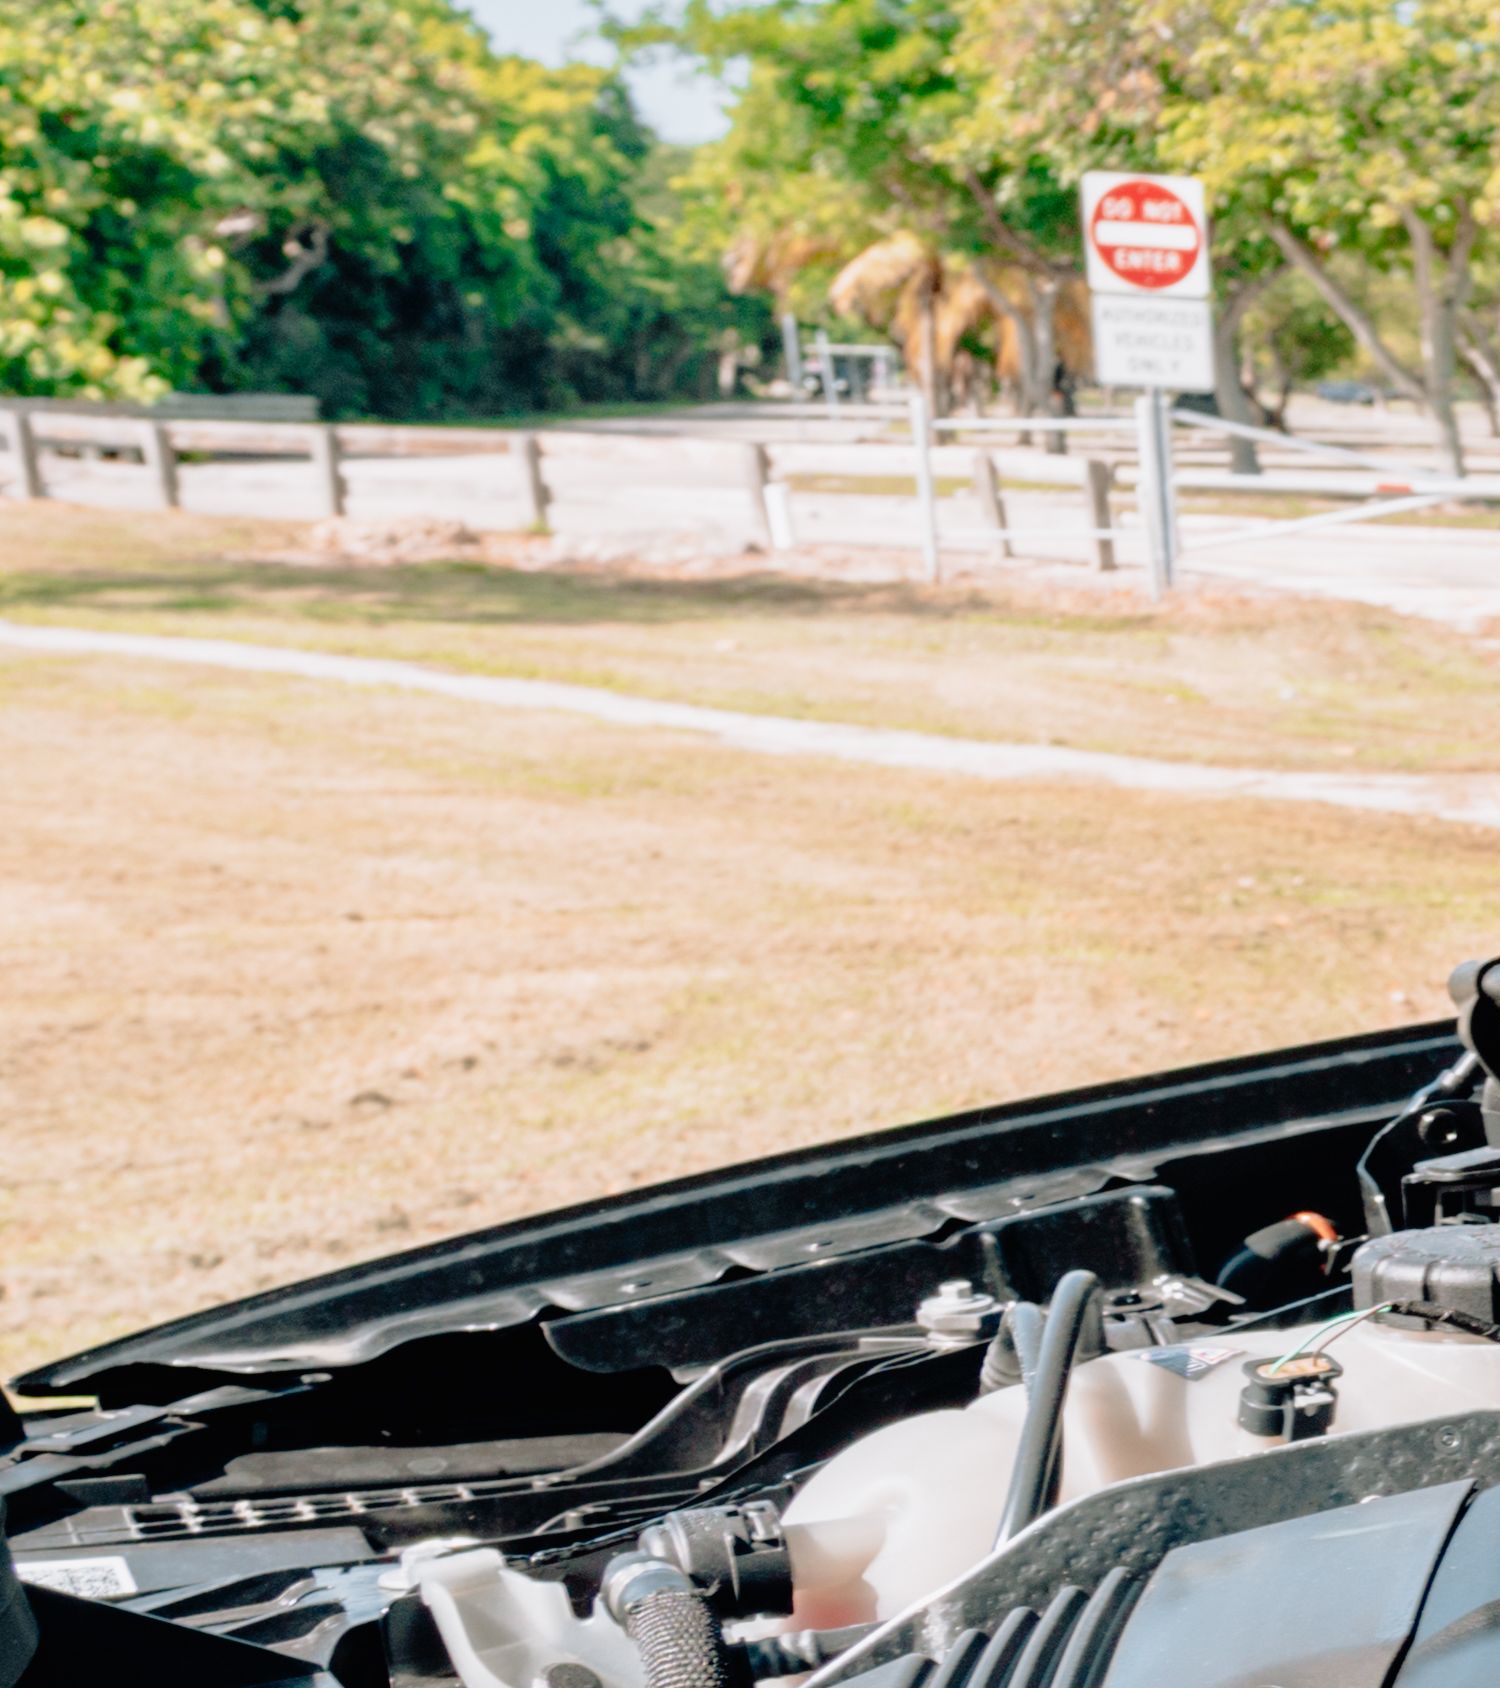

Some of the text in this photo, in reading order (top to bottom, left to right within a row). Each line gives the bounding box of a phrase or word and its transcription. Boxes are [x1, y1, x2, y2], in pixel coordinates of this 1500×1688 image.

[1101, 197, 1183, 222] DO NOT
[1113, 248, 1181, 273] ENTER
